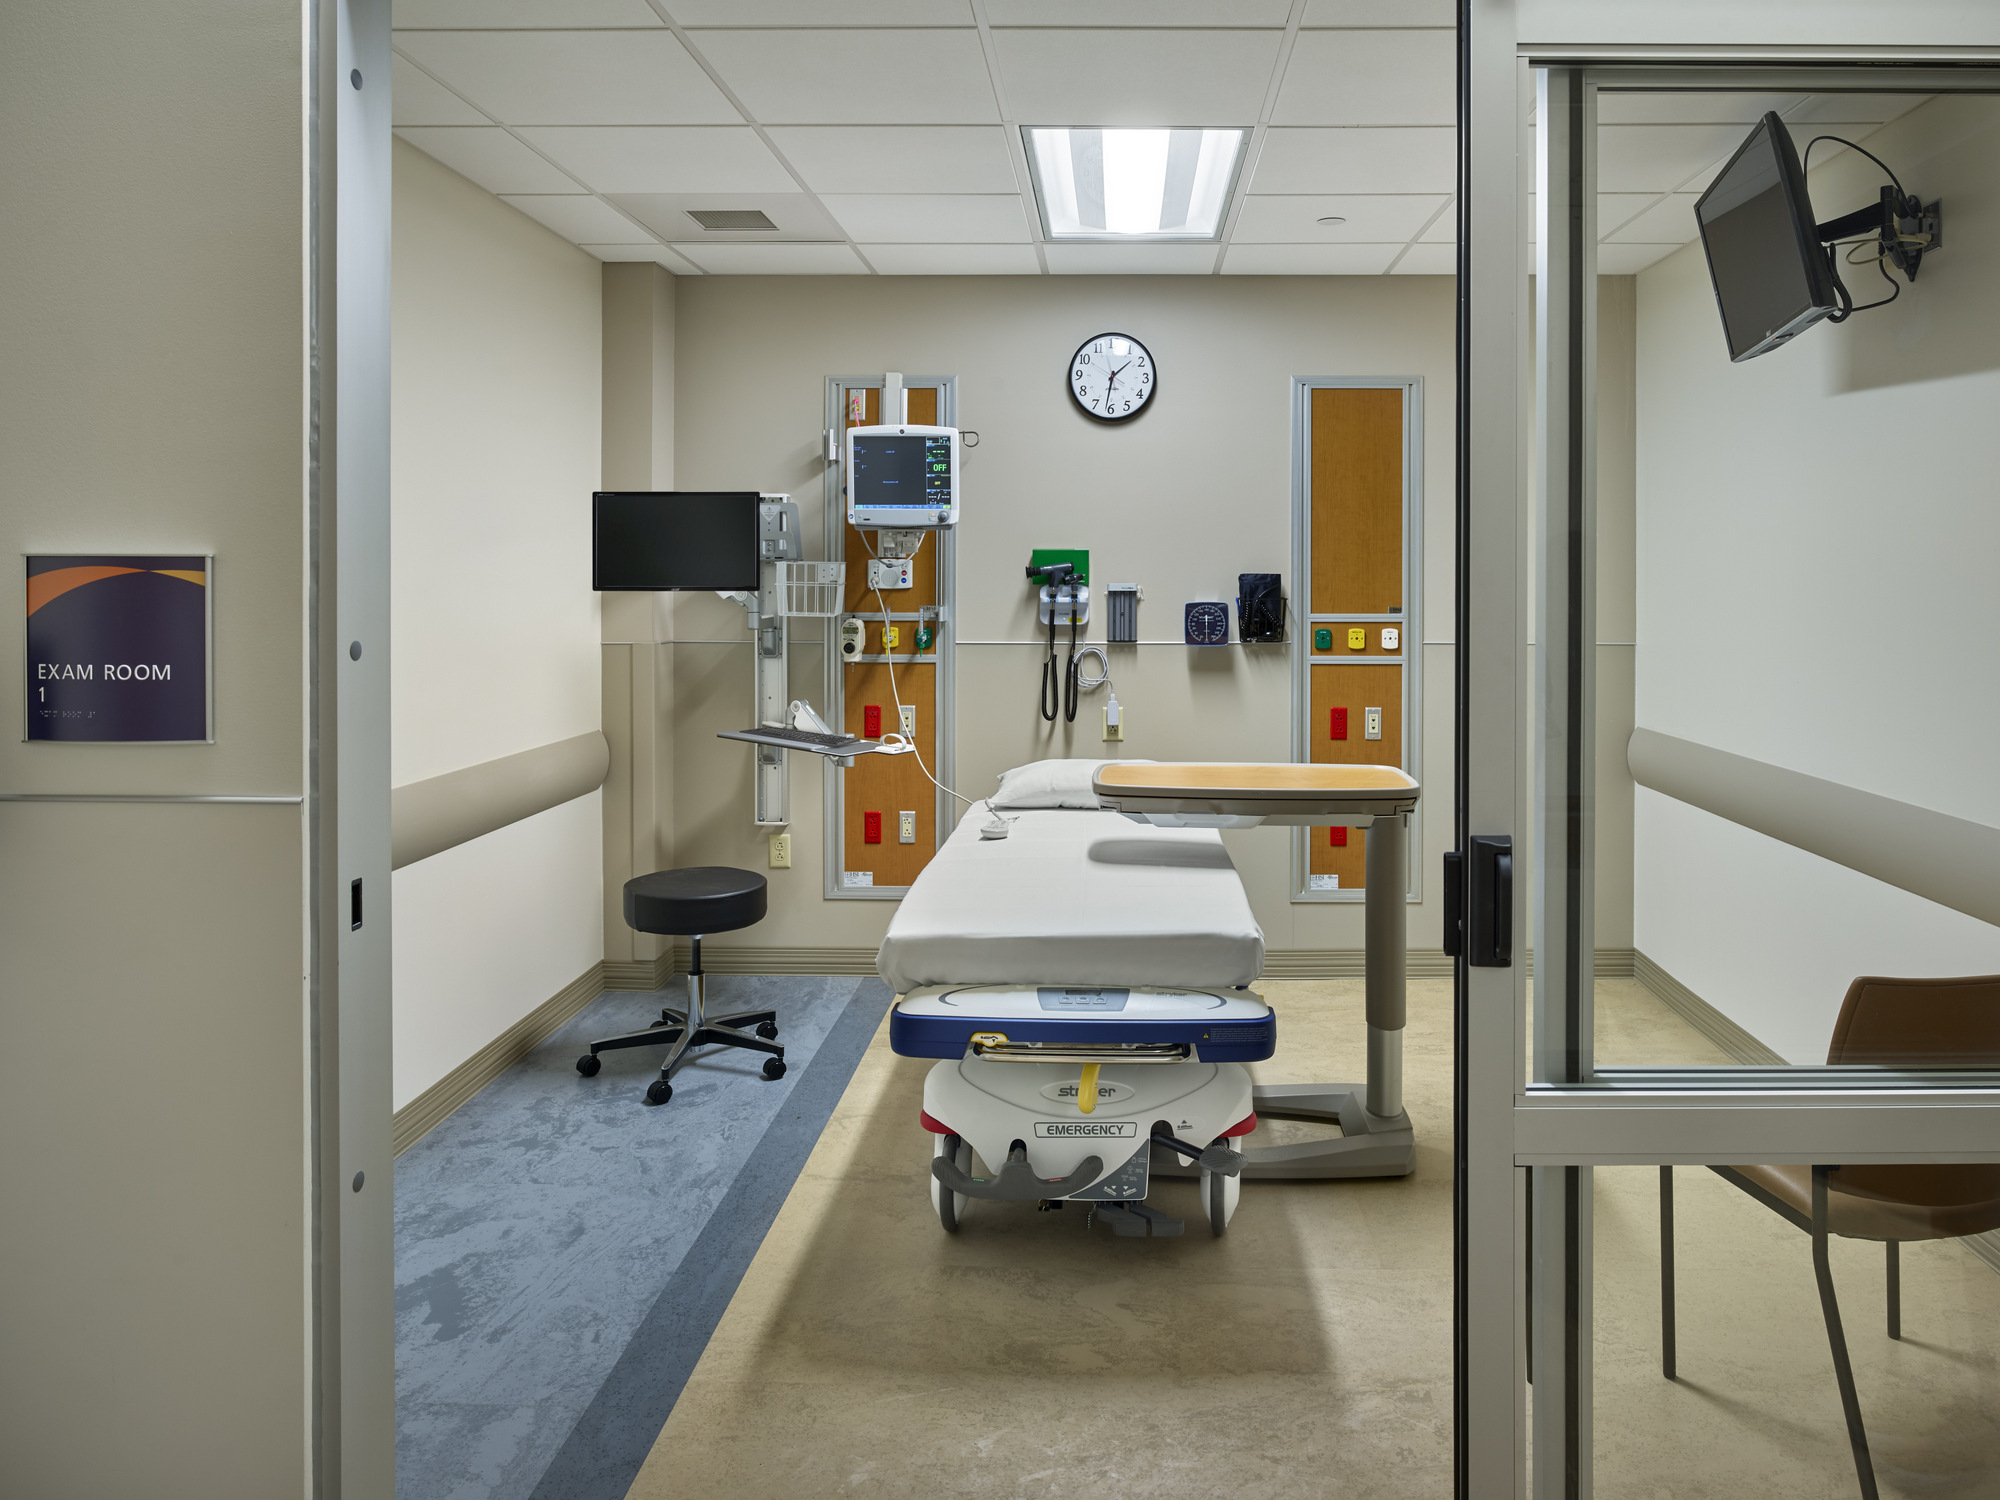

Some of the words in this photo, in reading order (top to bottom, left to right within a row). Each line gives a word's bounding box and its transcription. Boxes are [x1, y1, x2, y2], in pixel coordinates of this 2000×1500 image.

[1094, 343, 1102, 353] 11
[1128, 344, 1132, 354] 1
[1079, 354, 1090, 364] 10
[1138, 357, 1145, 367] 2
[1075, 370, 1083, 380] 9
[1142, 373, 1149, 384] 3
[1079, 385, 1087, 396] 8
[1136, 389, 1144, 399] 4
[1092, 399, 1099, 410] 7
[1107, 403, 1115, 414] 6
[1123, 401, 1130, 411] 5
[933, 464, 947, 472] OFF
[38, 664, 93, 680] EXAM
[104, 664, 170, 680] ROOM
[39, 687, 44, 702] 1
[1058, 1085, 1116, 1097] strer
[1047, 1125, 1124, 1135] EMERGENCY
